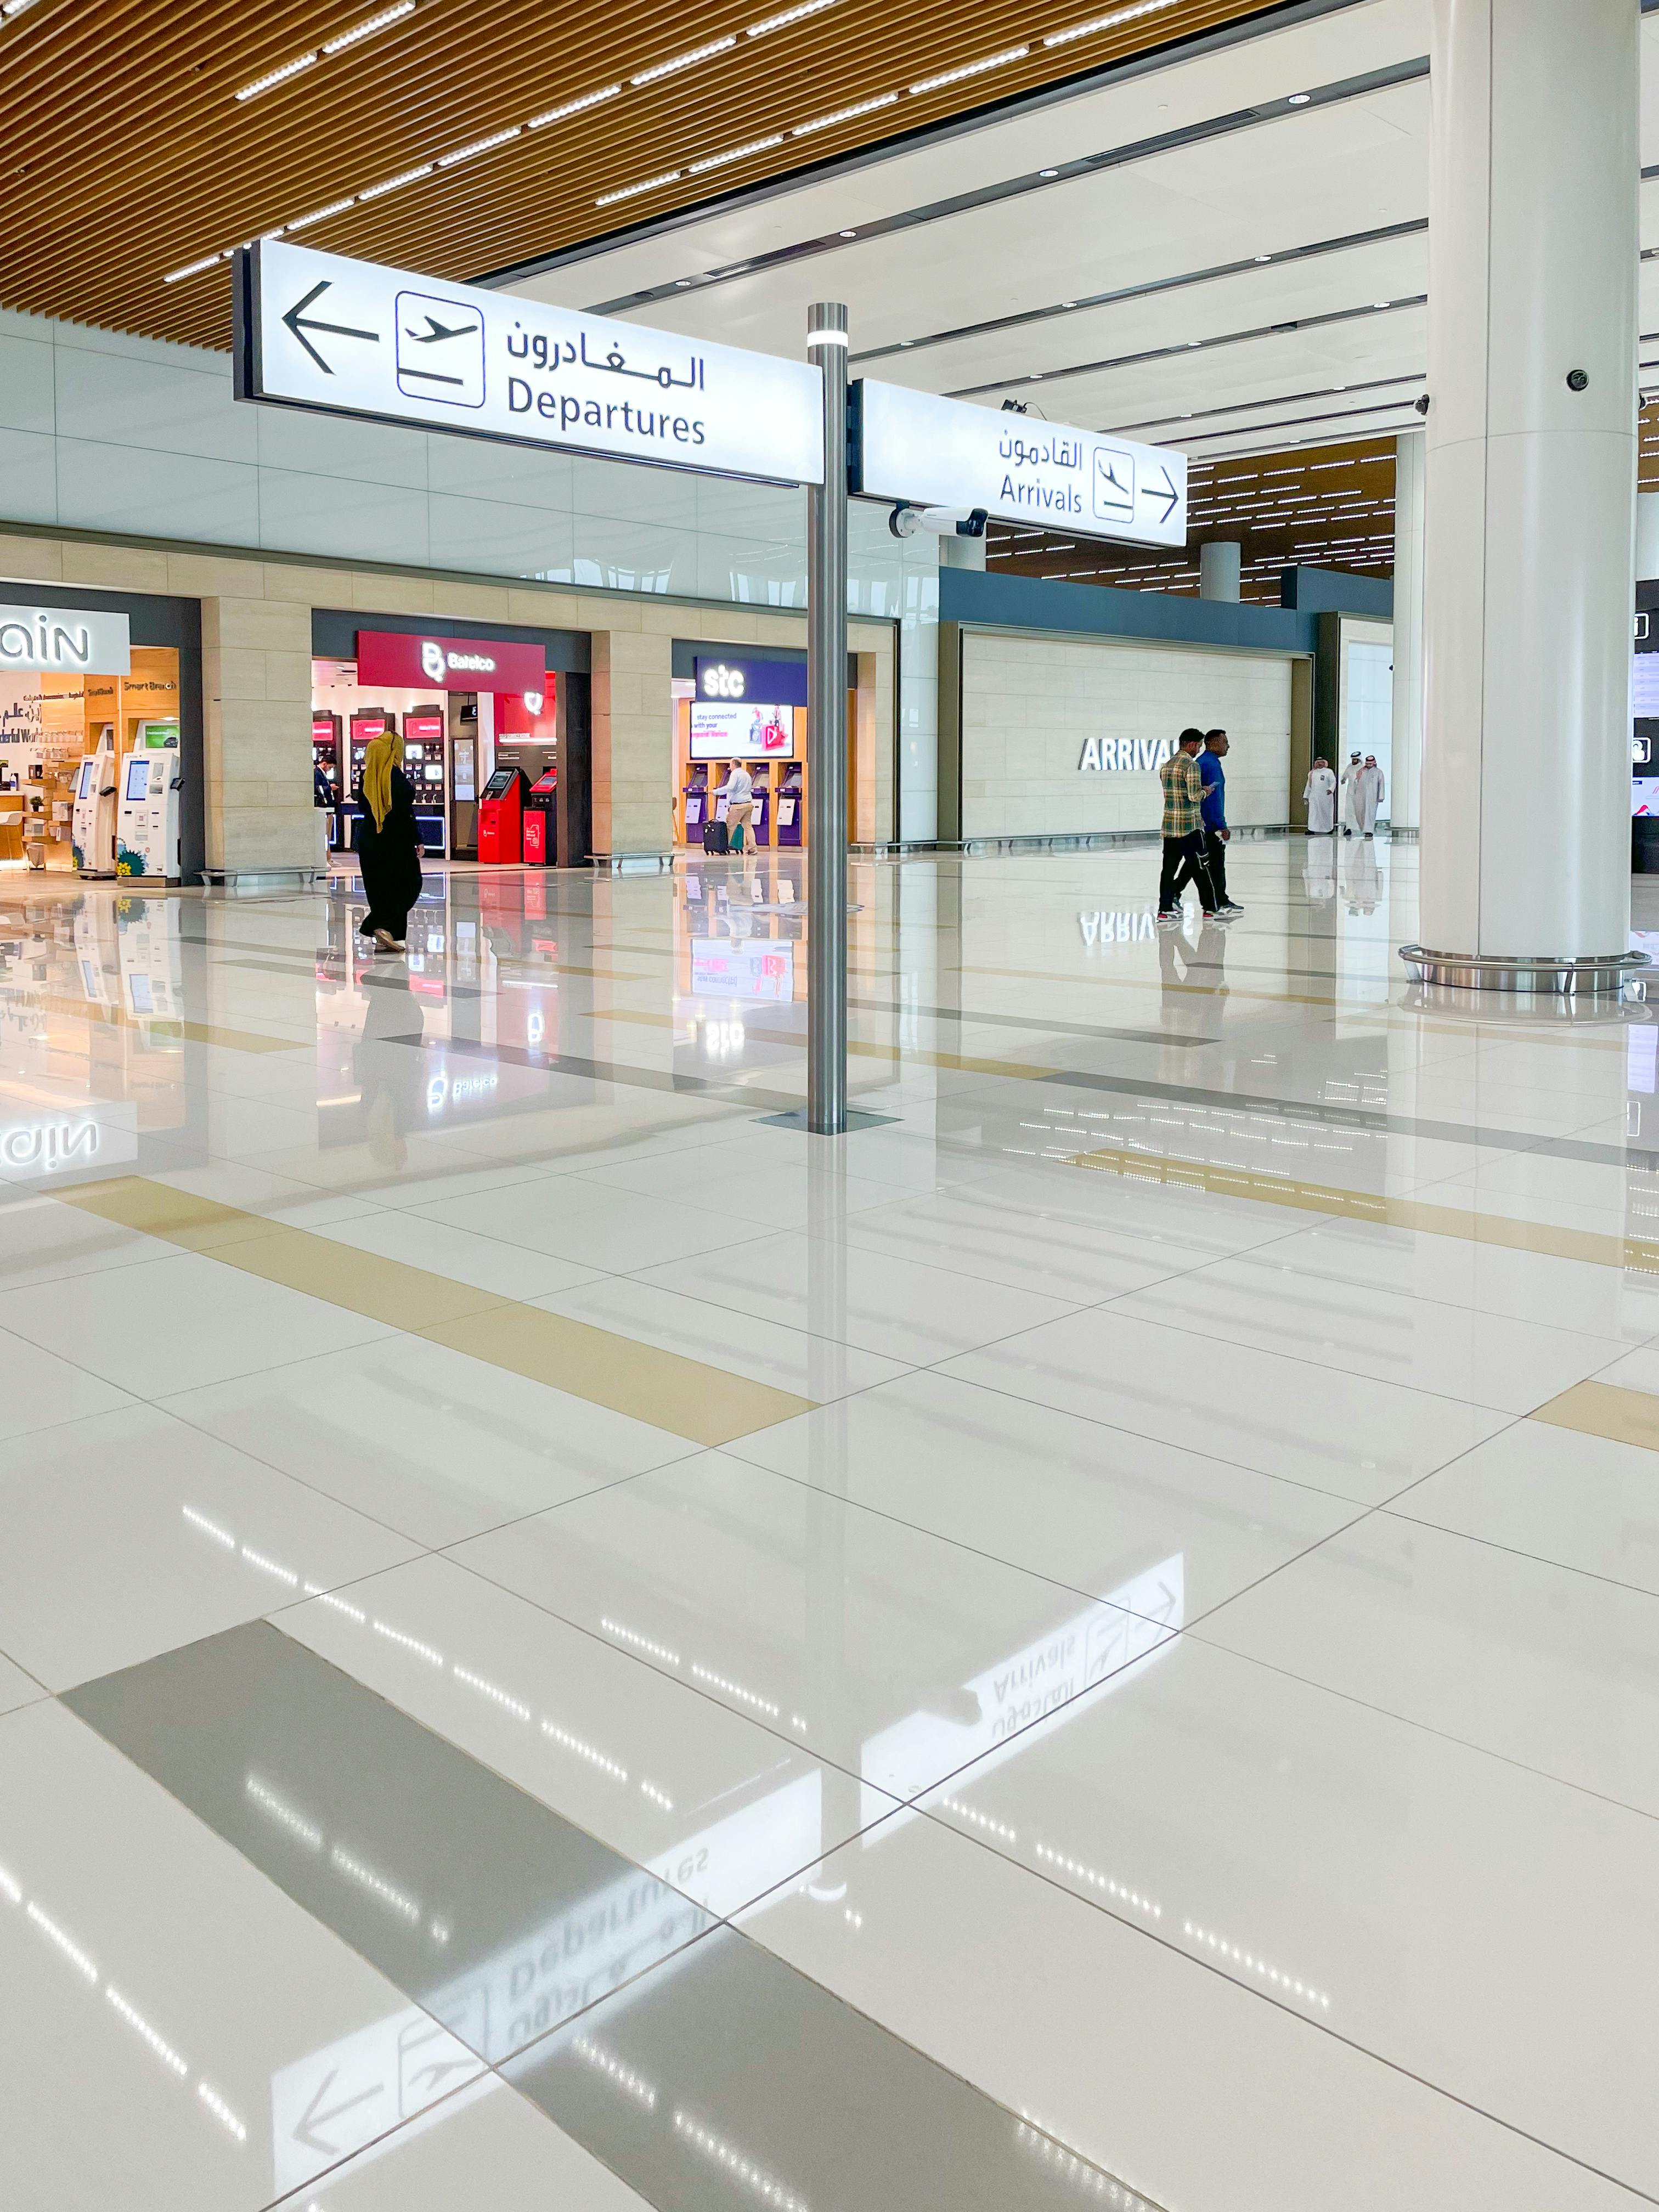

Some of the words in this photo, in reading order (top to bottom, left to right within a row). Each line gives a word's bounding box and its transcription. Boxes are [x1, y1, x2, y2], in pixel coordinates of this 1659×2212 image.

[507, 321, 704, 391] المغادرون
[508, 376, 705, 444] Departures
[999, 429, 1082, 471] القادمون
[1000, 475, 1082, 513] Arrivals
[447, 652, 496, 672] Batelco
[123, 681, 149, 691] Smart
[703, 664, 744, 697] stc
[1079, 737, 1180, 771] ARRIVA
